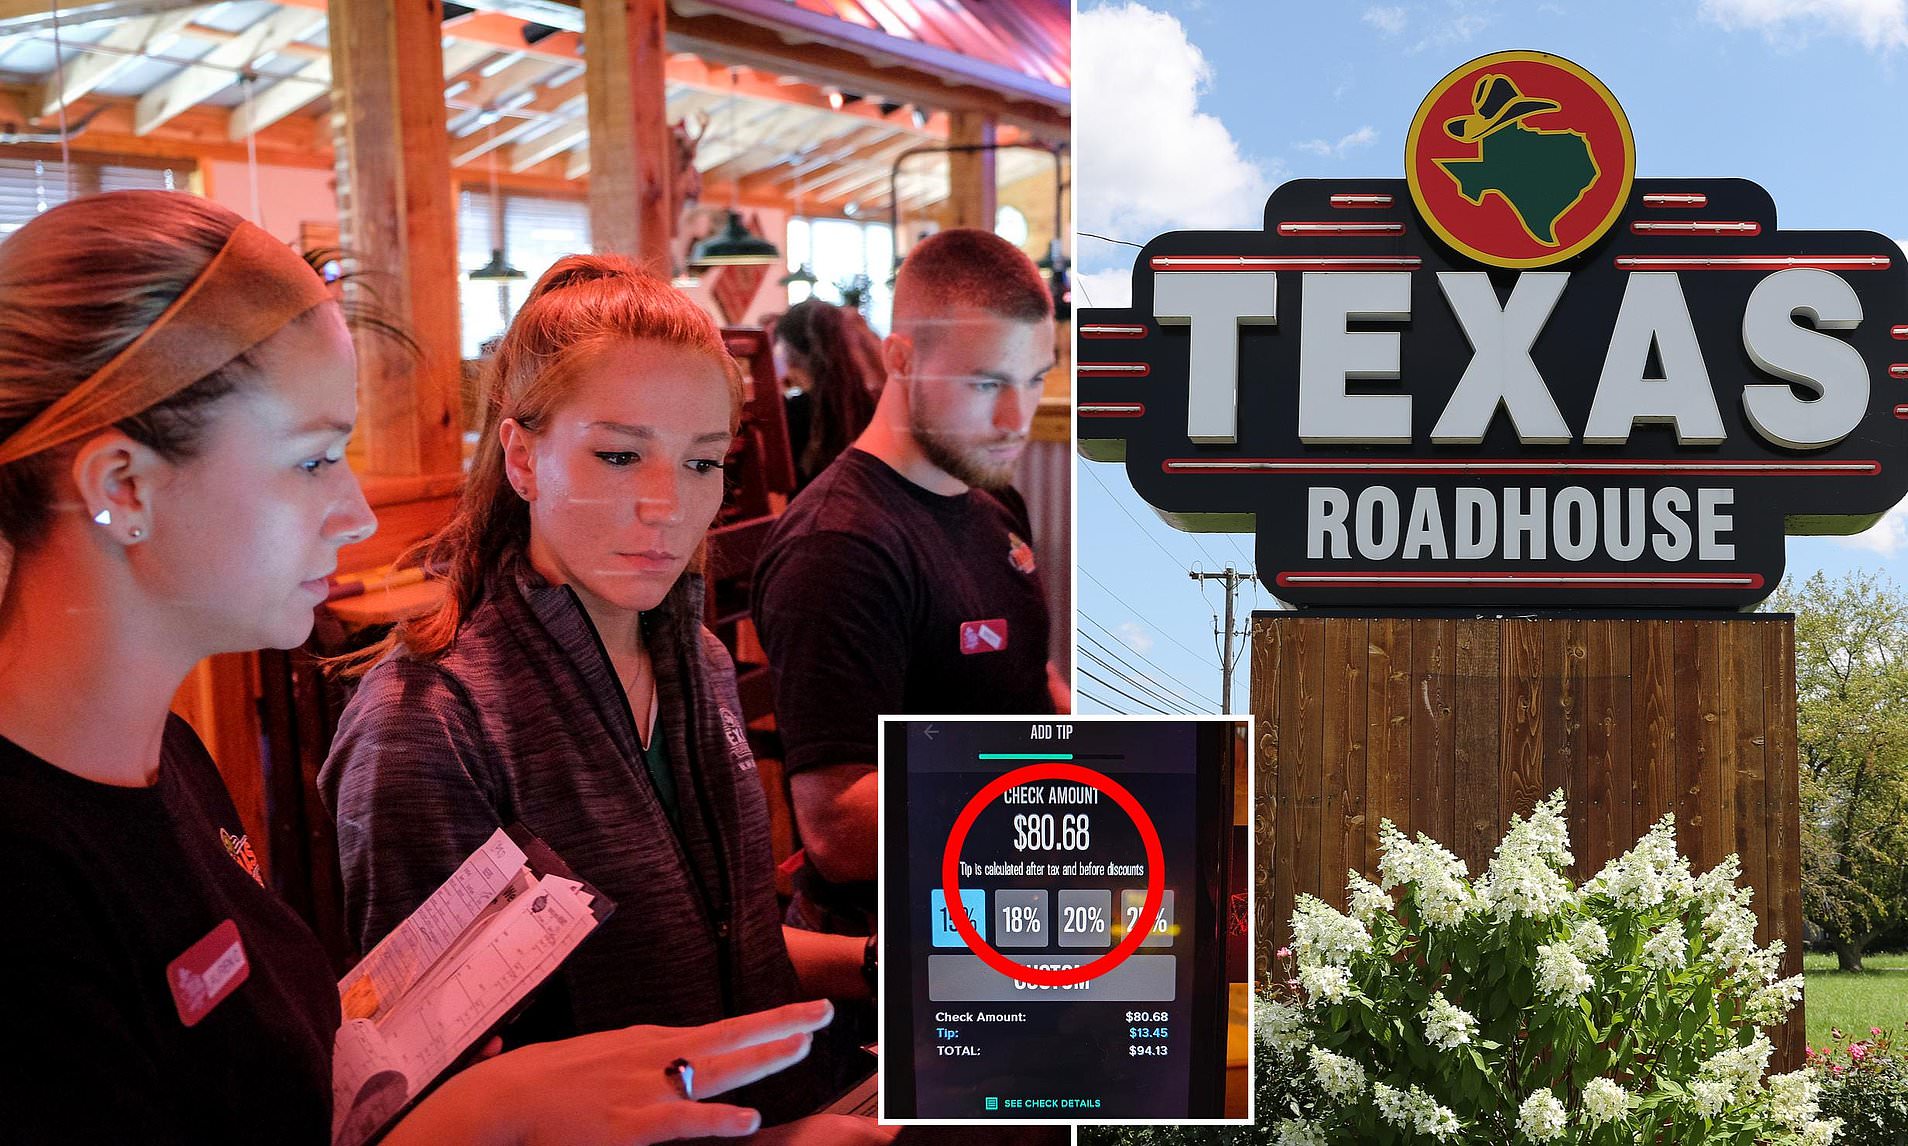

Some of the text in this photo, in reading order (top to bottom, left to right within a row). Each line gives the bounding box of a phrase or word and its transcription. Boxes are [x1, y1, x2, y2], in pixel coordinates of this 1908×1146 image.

[1153, 267, 1871, 450] TEXAS
[1306, 485, 1737, 562] ROADHOUSE
[1030, 724, 1073, 740] ADD TIP
[1004, 786, 1098, 805] CHECK AMOUNT
[1013, 813, 1090, 852] $80.68
[959, 861, 1145, 878] Tip is calculated after tax and before discounts
[1002, 906, 1041, 933] 18%
[1063, 906, 1105, 933] 20%
[935, 1011, 1027, 1023] Check Amount:
[1125, 1011, 1169, 1023] $80.68
[936, 1027, 959, 1041] Tip:
[1129, 1027, 1168, 1039] $13.45
[936, 1045, 981, 1057] TOTAL:
[1128, 1045, 1168, 1057] $94.13
[1004, 1099, 1101, 1108] SEE CHECK DETAILS
